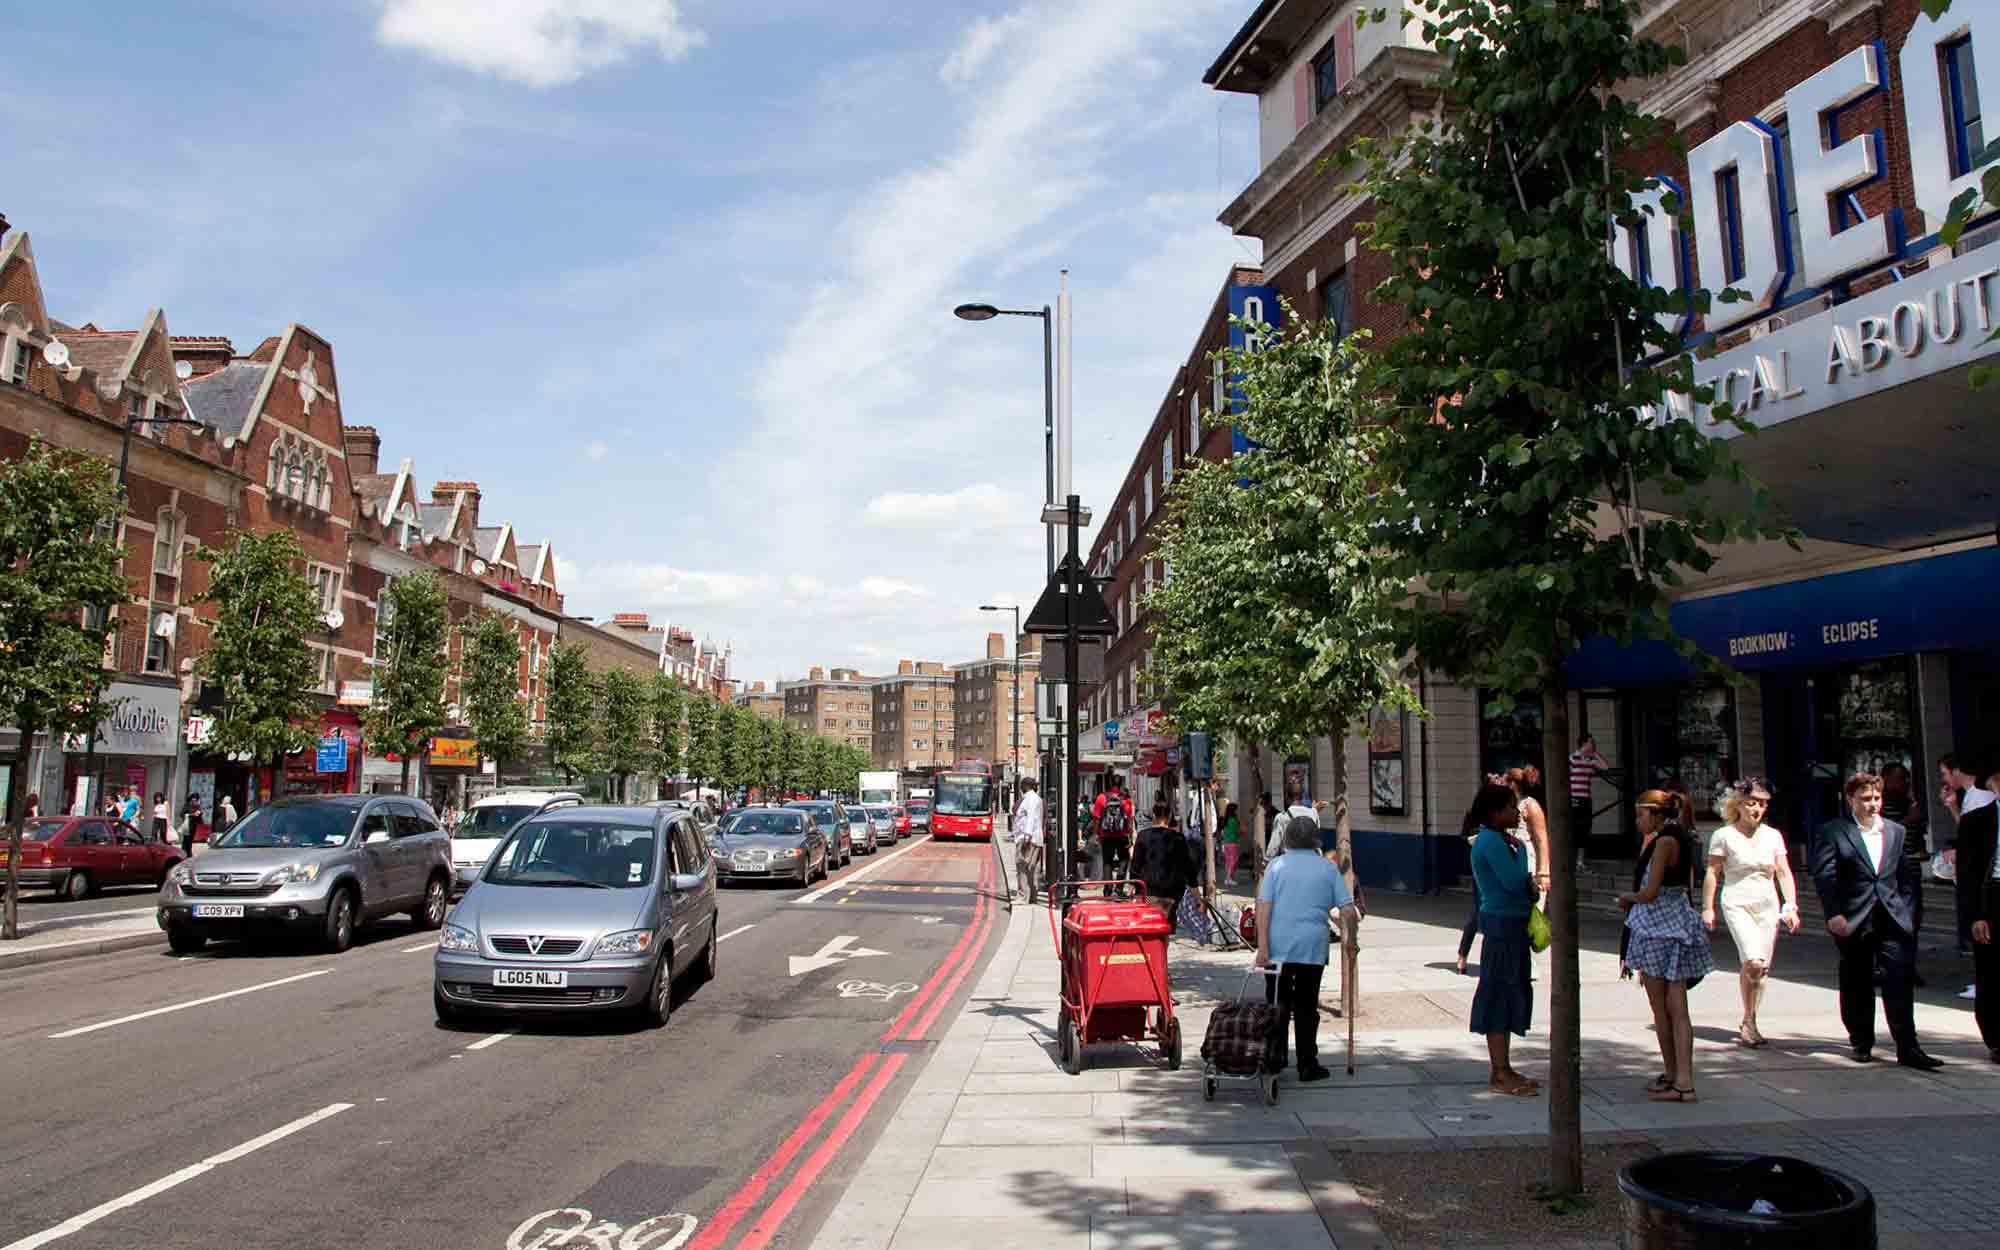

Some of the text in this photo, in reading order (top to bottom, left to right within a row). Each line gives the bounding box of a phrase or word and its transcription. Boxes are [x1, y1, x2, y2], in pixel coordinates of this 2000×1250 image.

[1825, 268, 2000, 386] ABOUT
[1822, 618, 1879, 644] ECLIPSE
[498, 971, 563, 985] LG05 NLJ
